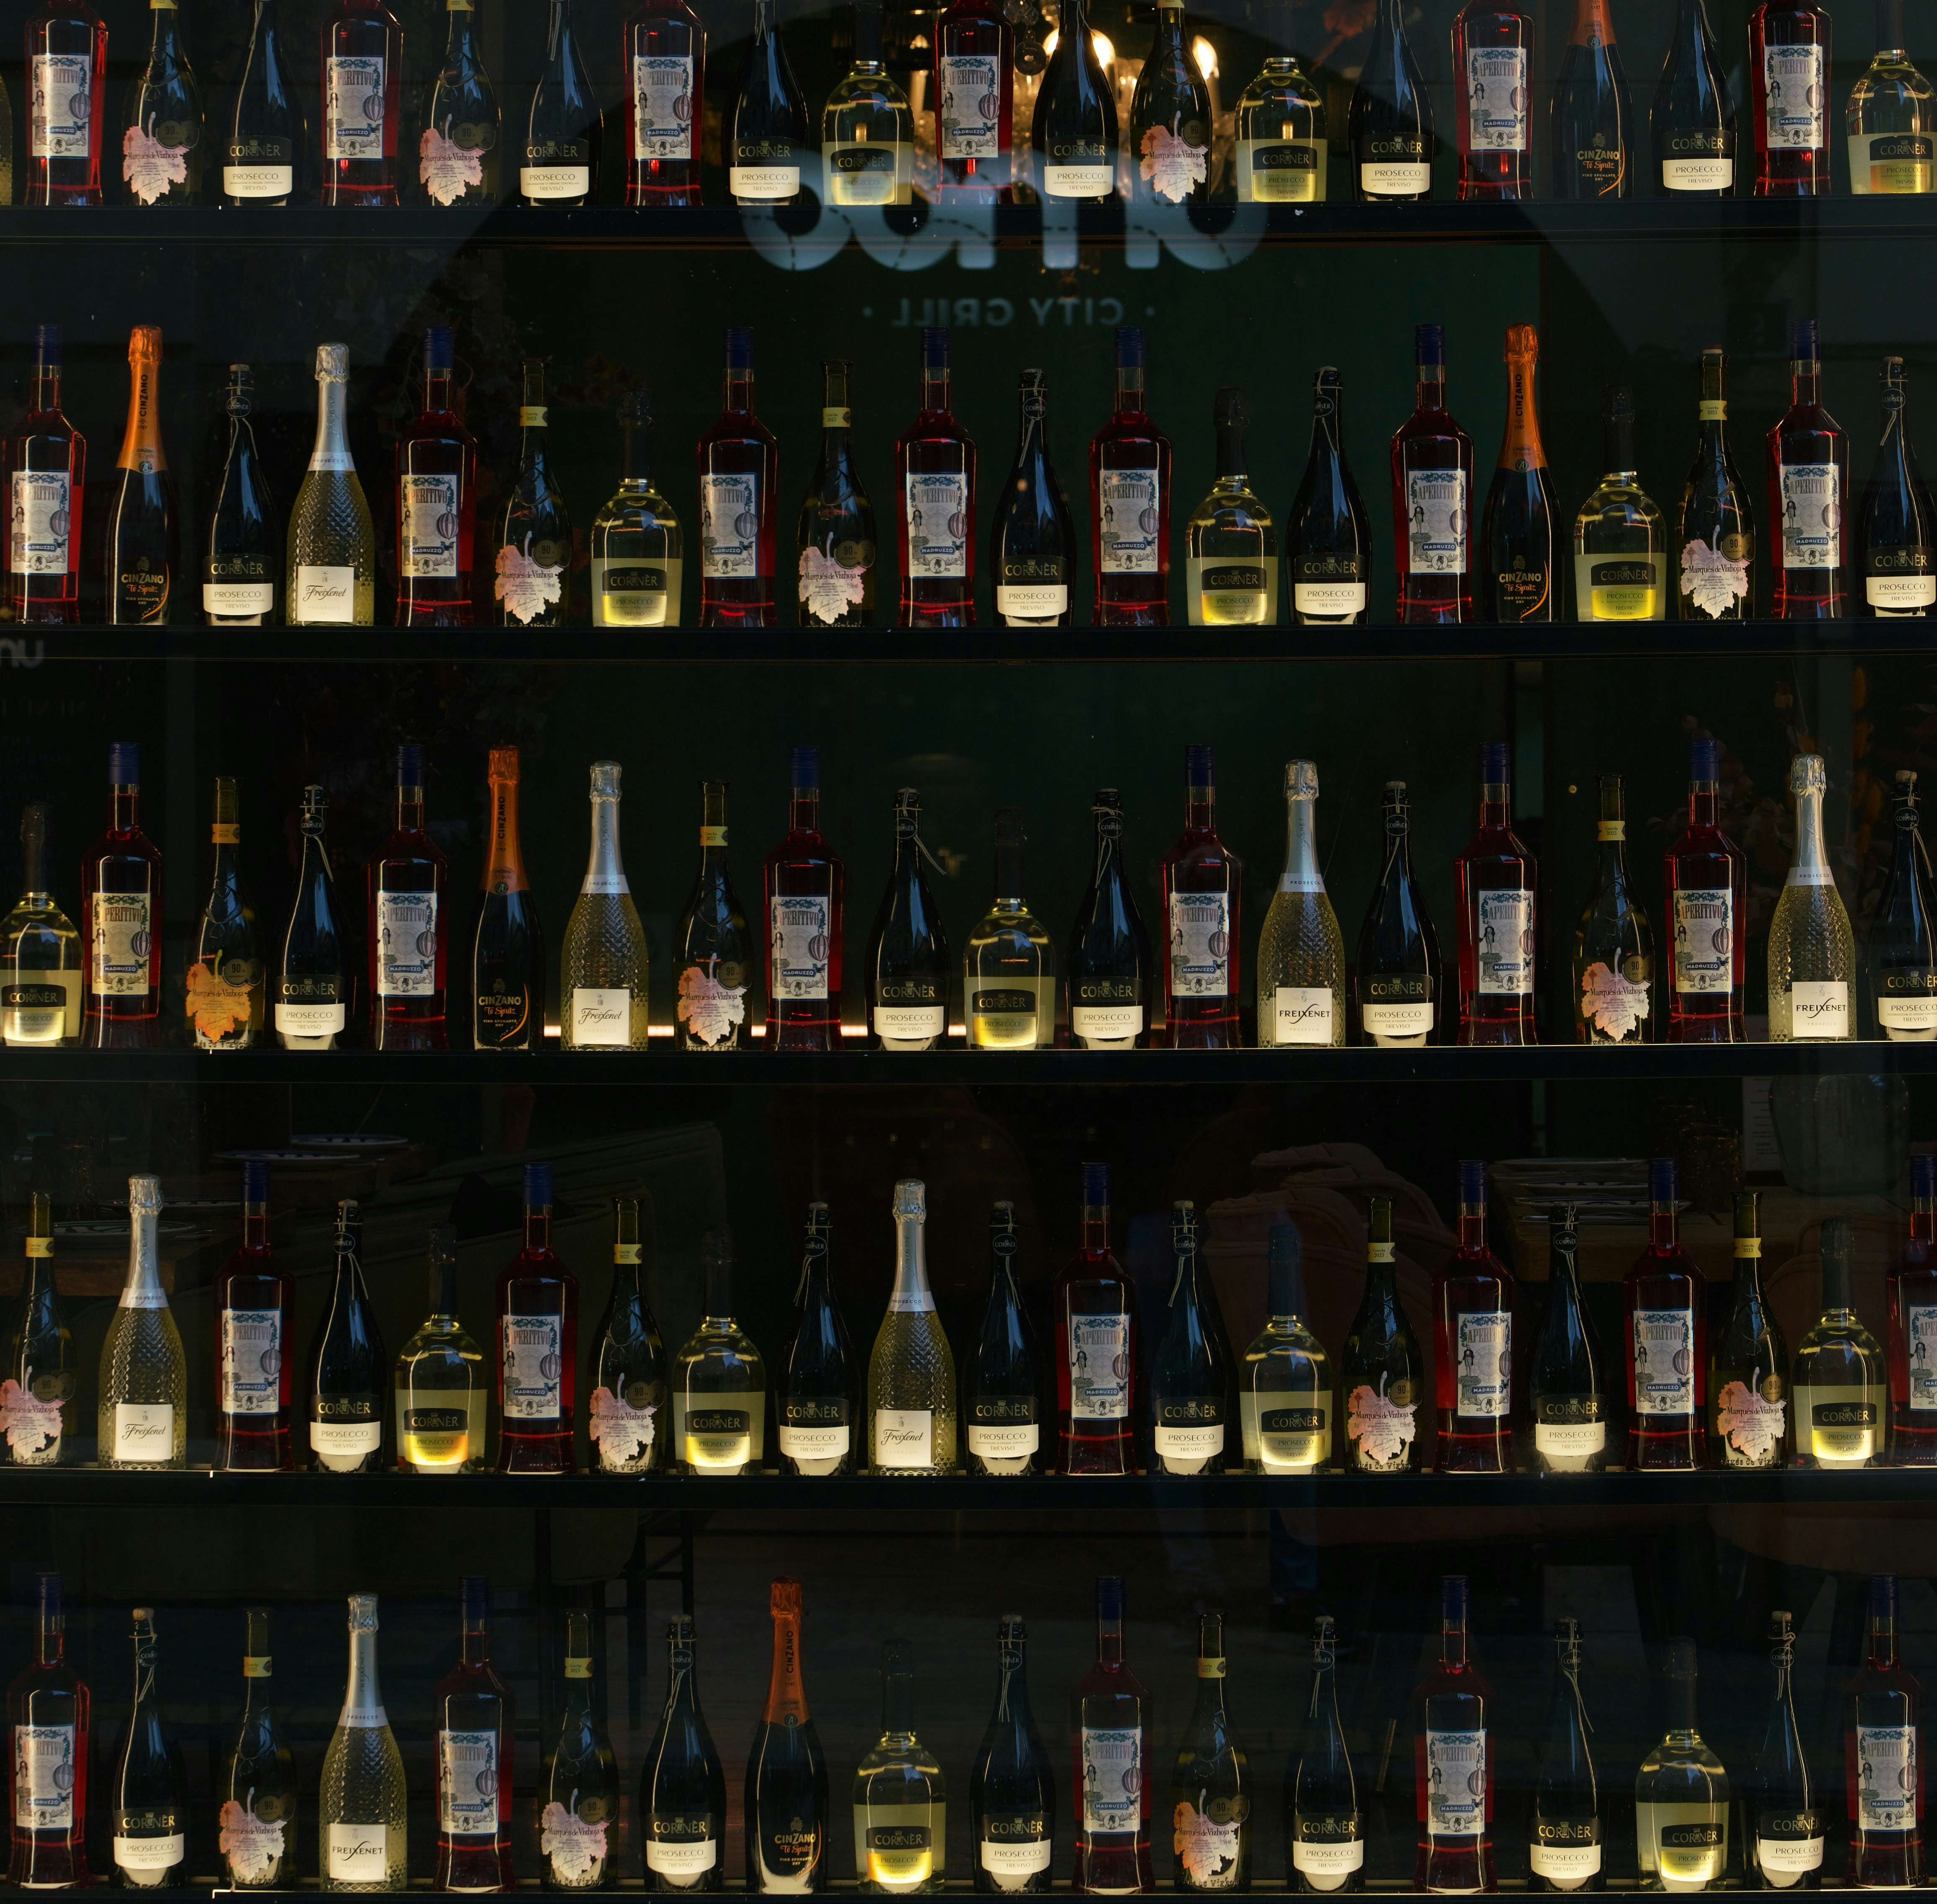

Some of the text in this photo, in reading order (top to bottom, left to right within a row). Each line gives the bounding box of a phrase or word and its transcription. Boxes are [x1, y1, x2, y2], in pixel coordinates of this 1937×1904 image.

[1150, 150, 1175, 161] Marqués
[1182, 150, 1201, 159] Vizhoja
[1577, 149, 1619, 160] CINZANO
[139, 374, 148, 417] CINZANO
[844, 546, 853, 555] 90
[1688, 565, 1714, 575] Marqués
[1721, 564, 1741, 573] Vizhoja
[121, 572, 164, 584] CINZANO
[805, 572, 828, 582] Marqués
[835, 571, 855, 580] Vizhoja
[1499, 572, 1541, 582] CINZANO
[303, 585, 347, 602] Freixenet
[685, 992, 710, 1003] Marqués
[717, 992, 737, 1001] Vizhoja
[1590, 987, 1616, 998] Marqués
[1623, 987, 1643, 996] Vizhoja
[478, 994, 522, 1006] CINZANO
[578, 1008, 622, 1024] Freixenet
[1356, 1411, 1381, 1421] Marqués
[1388, 1410, 1408, 1419] Vizhoja
[1727, 1406, 1753, 1416] Marqués
[1760, 1406, 1779, 1415] Vizhoja
[122, 1424, 166, 1440] Freixenet
[881, 1429, 923, 1445] Freixenet
[1168, 1433, 1214, 1442] PROSECCO
[1549, 1430, 1596, 1439] PROSECCO
[1179, 1827, 1201, 1837] Marqués
[1207, 1828, 1229, 1837] Vizhoja
[774, 1832, 817, 1845] CINZANO
[1306, 1849, 1353, 1858] PROSECCO
[1775, 1845, 1819, 1854] PROSECCO
[1541, 1853, 1588, 1861] PROSECCO
